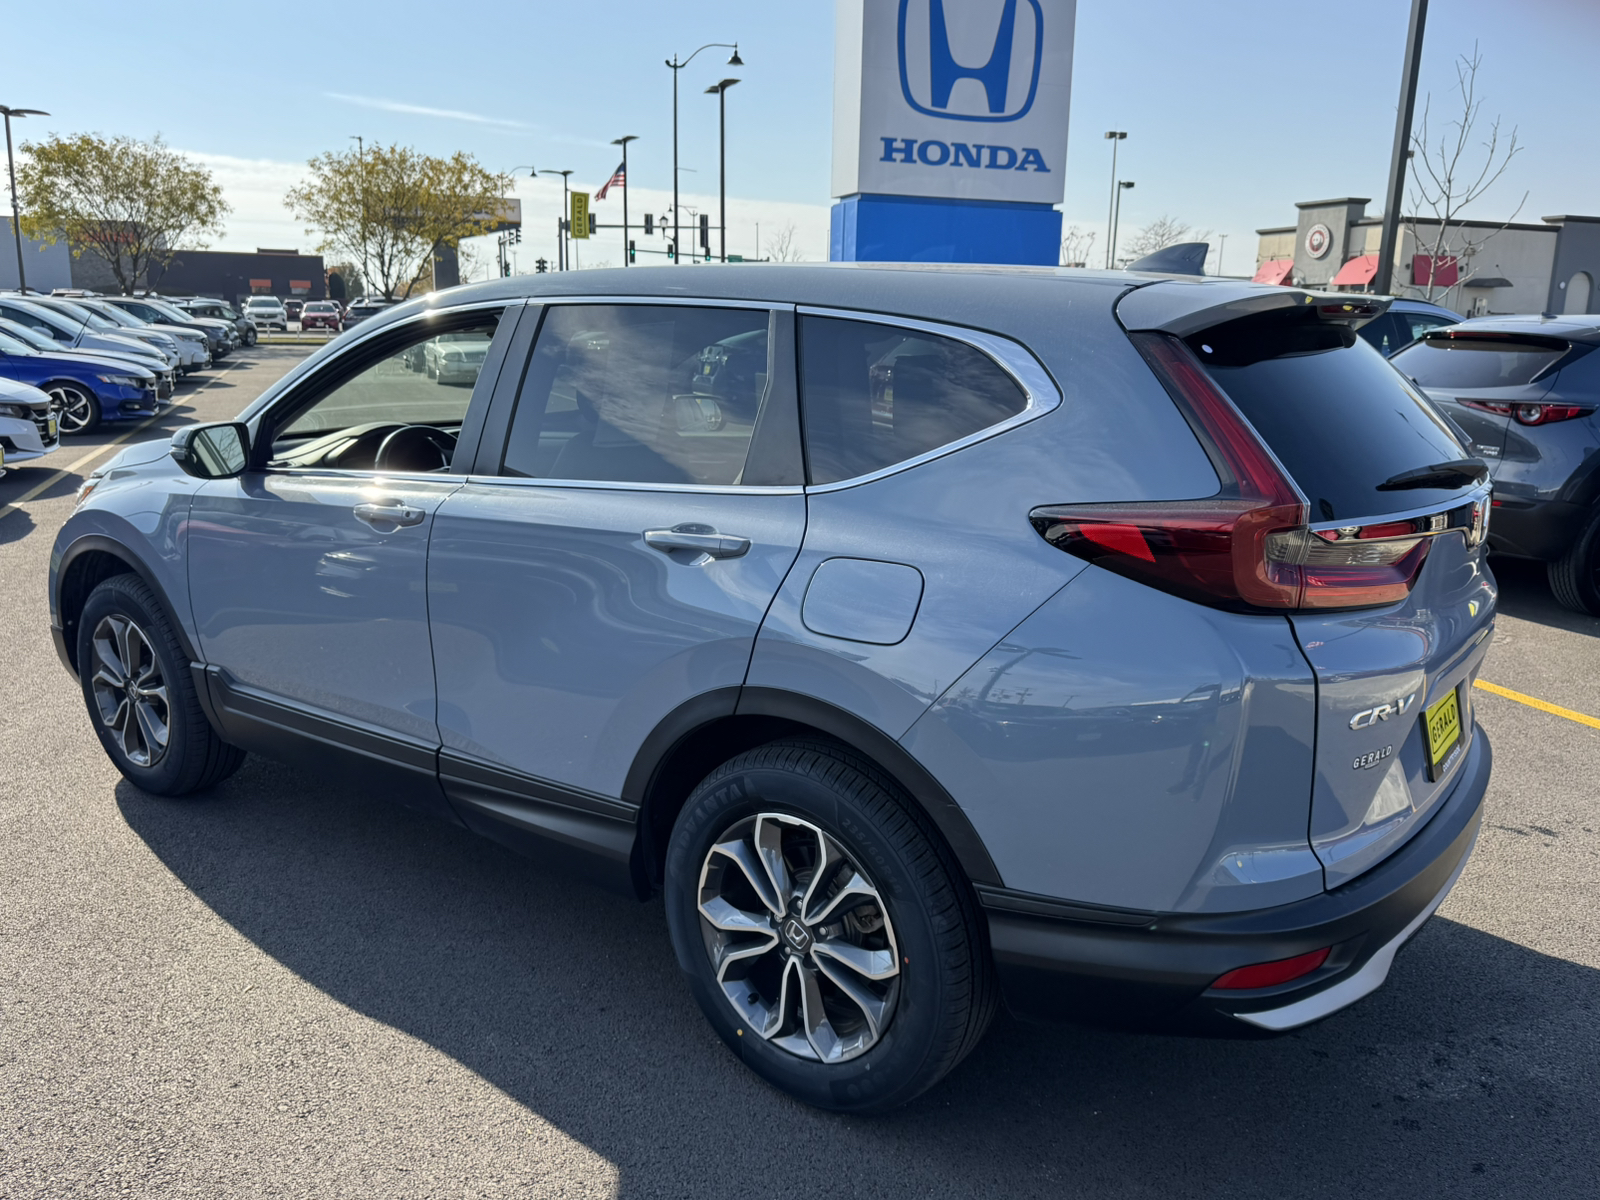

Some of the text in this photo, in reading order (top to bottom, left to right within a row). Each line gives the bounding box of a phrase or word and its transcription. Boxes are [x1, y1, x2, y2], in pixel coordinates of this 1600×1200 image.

[880, 137, 1051, 173] HONDA
[1349, 693, 1415, 730] CR-V
[1431, 703, 1456, 744] GERALD
[1353, 745, 1392, 769] GERALD
